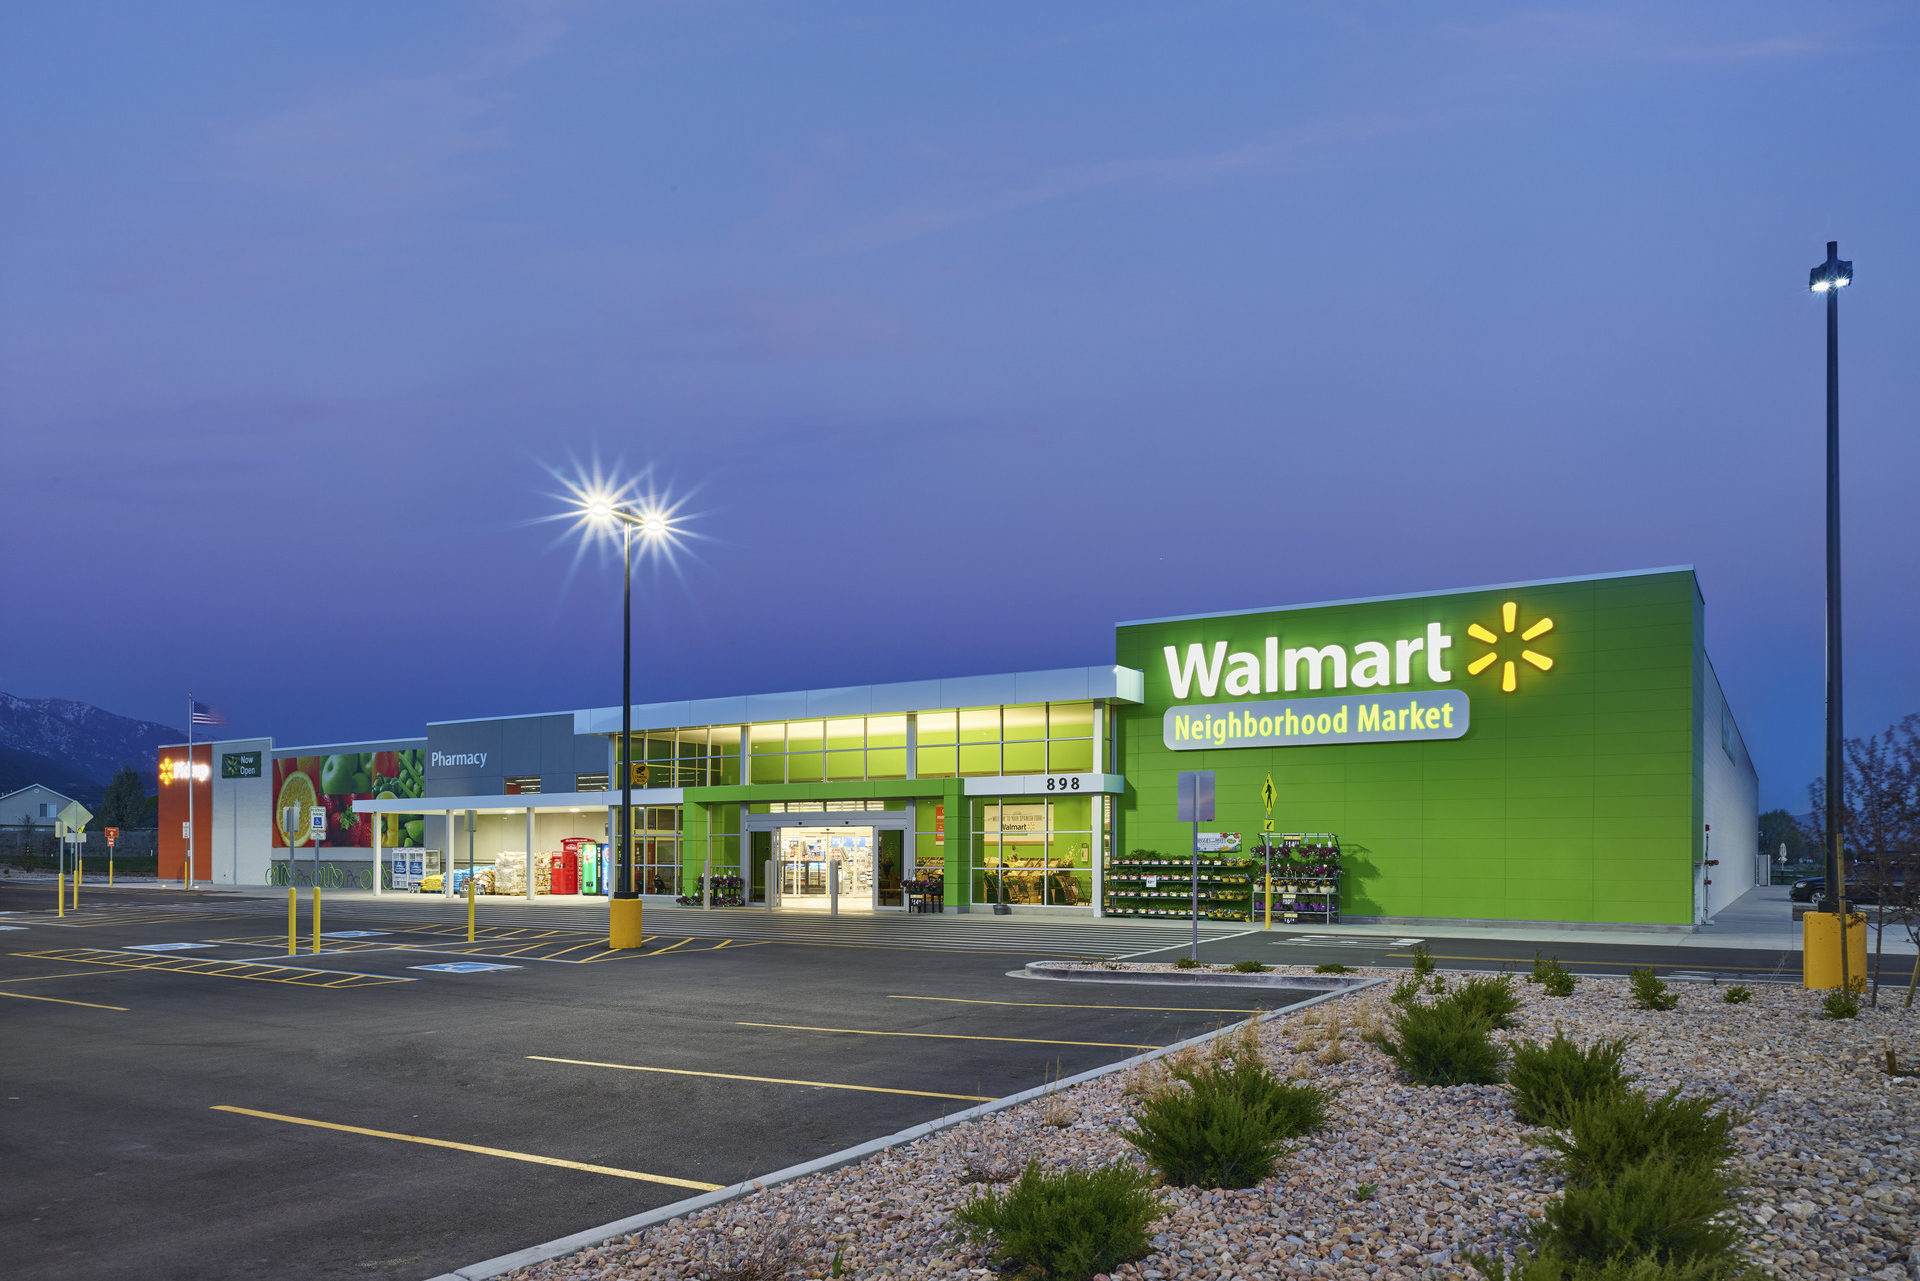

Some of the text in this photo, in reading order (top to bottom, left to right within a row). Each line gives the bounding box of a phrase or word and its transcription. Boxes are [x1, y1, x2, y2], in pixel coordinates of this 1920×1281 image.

[1163, 622, 1452, 699] Walmart
[1175, 701, 1454, 746] Neighborhood Market
[240, 755, 253, 764] Now
[431, 751, 487, 768] Pharmacy
[240, 766, 256, 776] Open
[1047, 777, 1080, 790] 898
